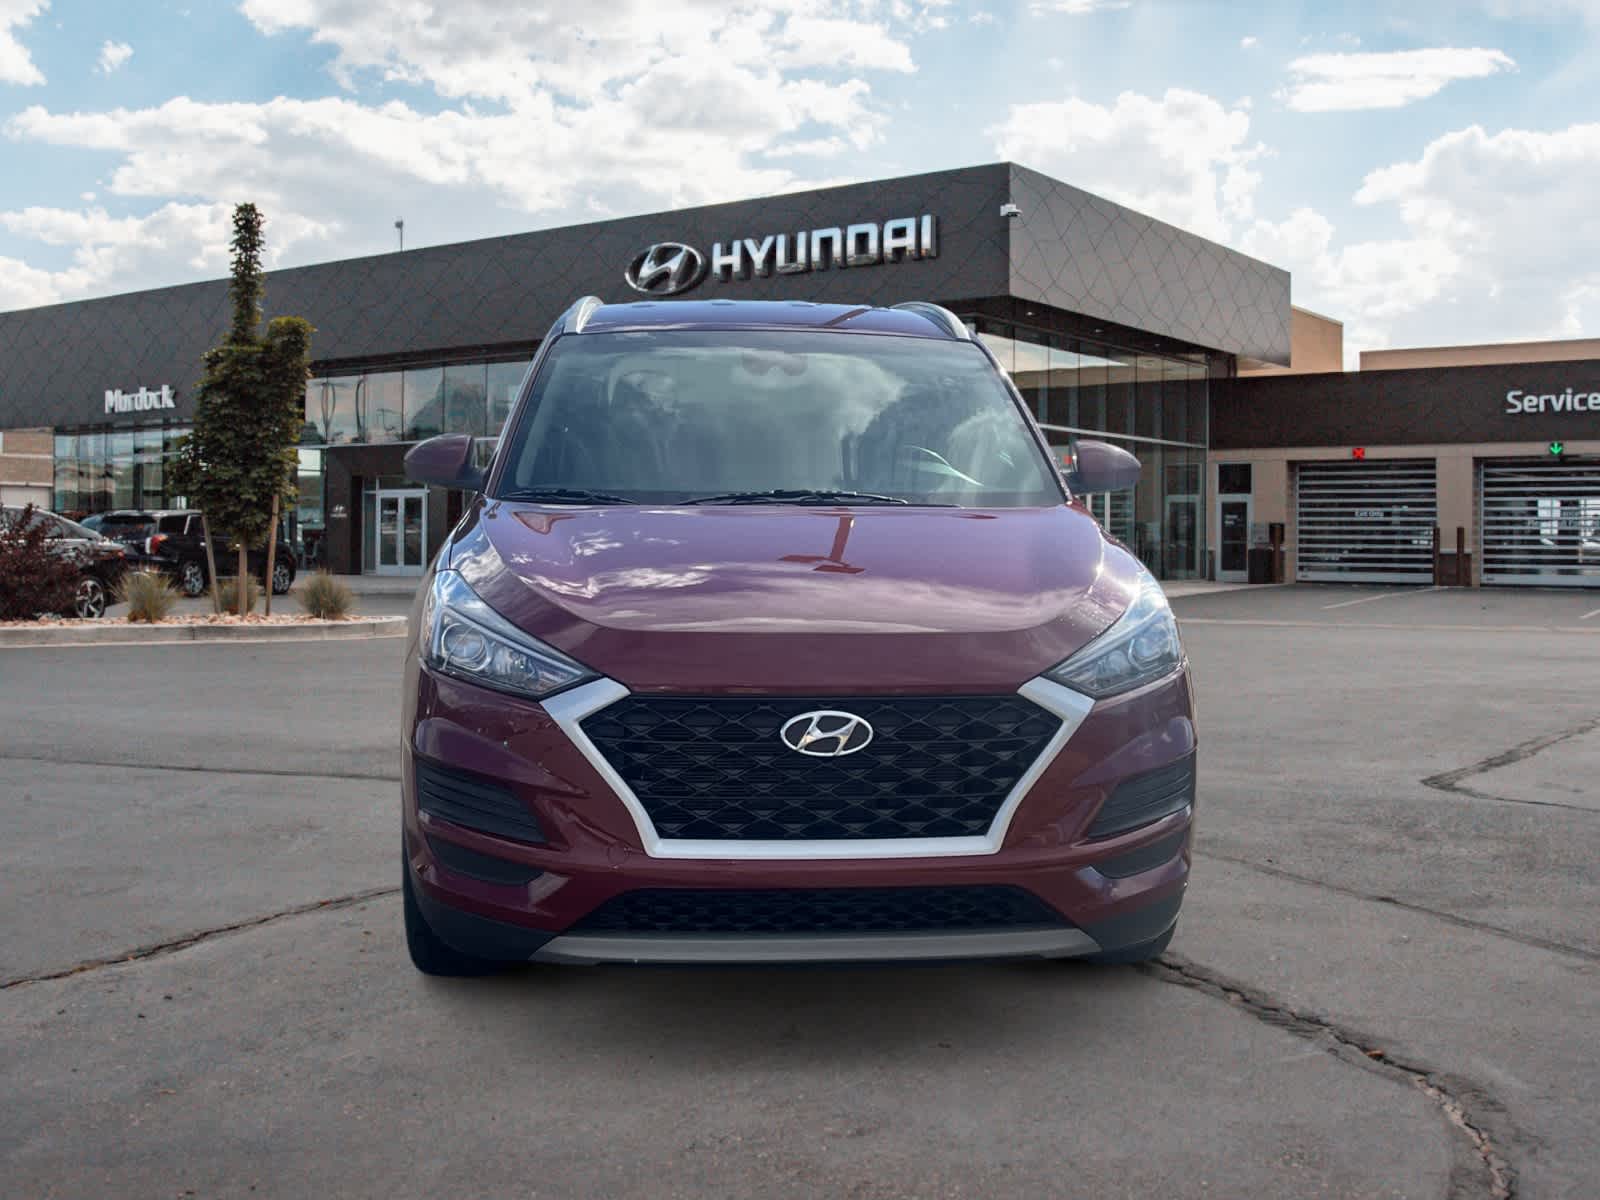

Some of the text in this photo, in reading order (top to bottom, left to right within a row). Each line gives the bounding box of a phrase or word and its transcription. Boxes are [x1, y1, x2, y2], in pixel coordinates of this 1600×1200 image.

[712, 214, 937, 282] HYUNDAI
[104, 384, 176, 413] Murdock
[1505, 387, 1600, 413] Service
